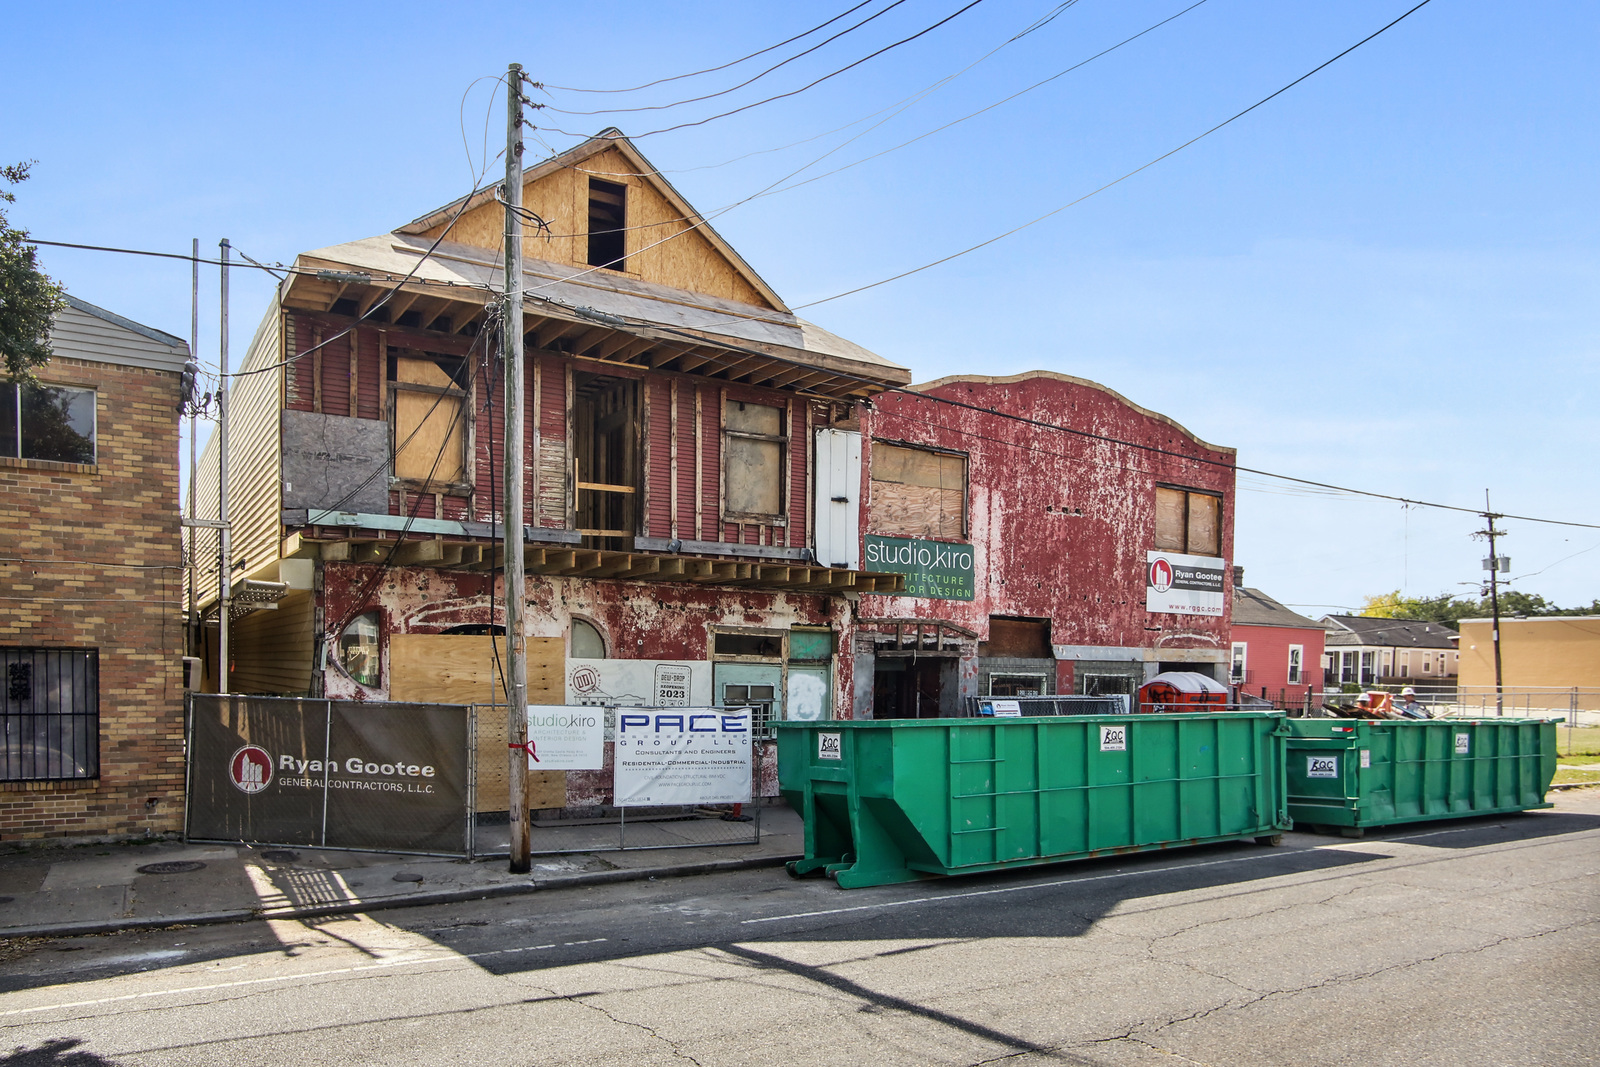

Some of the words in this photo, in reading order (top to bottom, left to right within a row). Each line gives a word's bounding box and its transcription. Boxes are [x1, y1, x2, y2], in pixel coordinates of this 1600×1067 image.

[1175, 570, 1194, 579] Ryan
[1195, 572, 1222, 581] Gootee
[930, 587, 971, 597] DESIGN
[1168, 604, 1222, 613] www.rggc.com
[576, 672, 594, 688] DDI
[660, 690, 685, 698] 2023
[620, 714, 748, 733] PACE
[279, 754, 339, 774] Ryan
[346, 757, 436, 778] Gootee
[279, 777, 325, 788] GENERAL
[328, 780, 406, 793] CONTRACTORS,
[407, 785, 436, 794] L.L.C.
